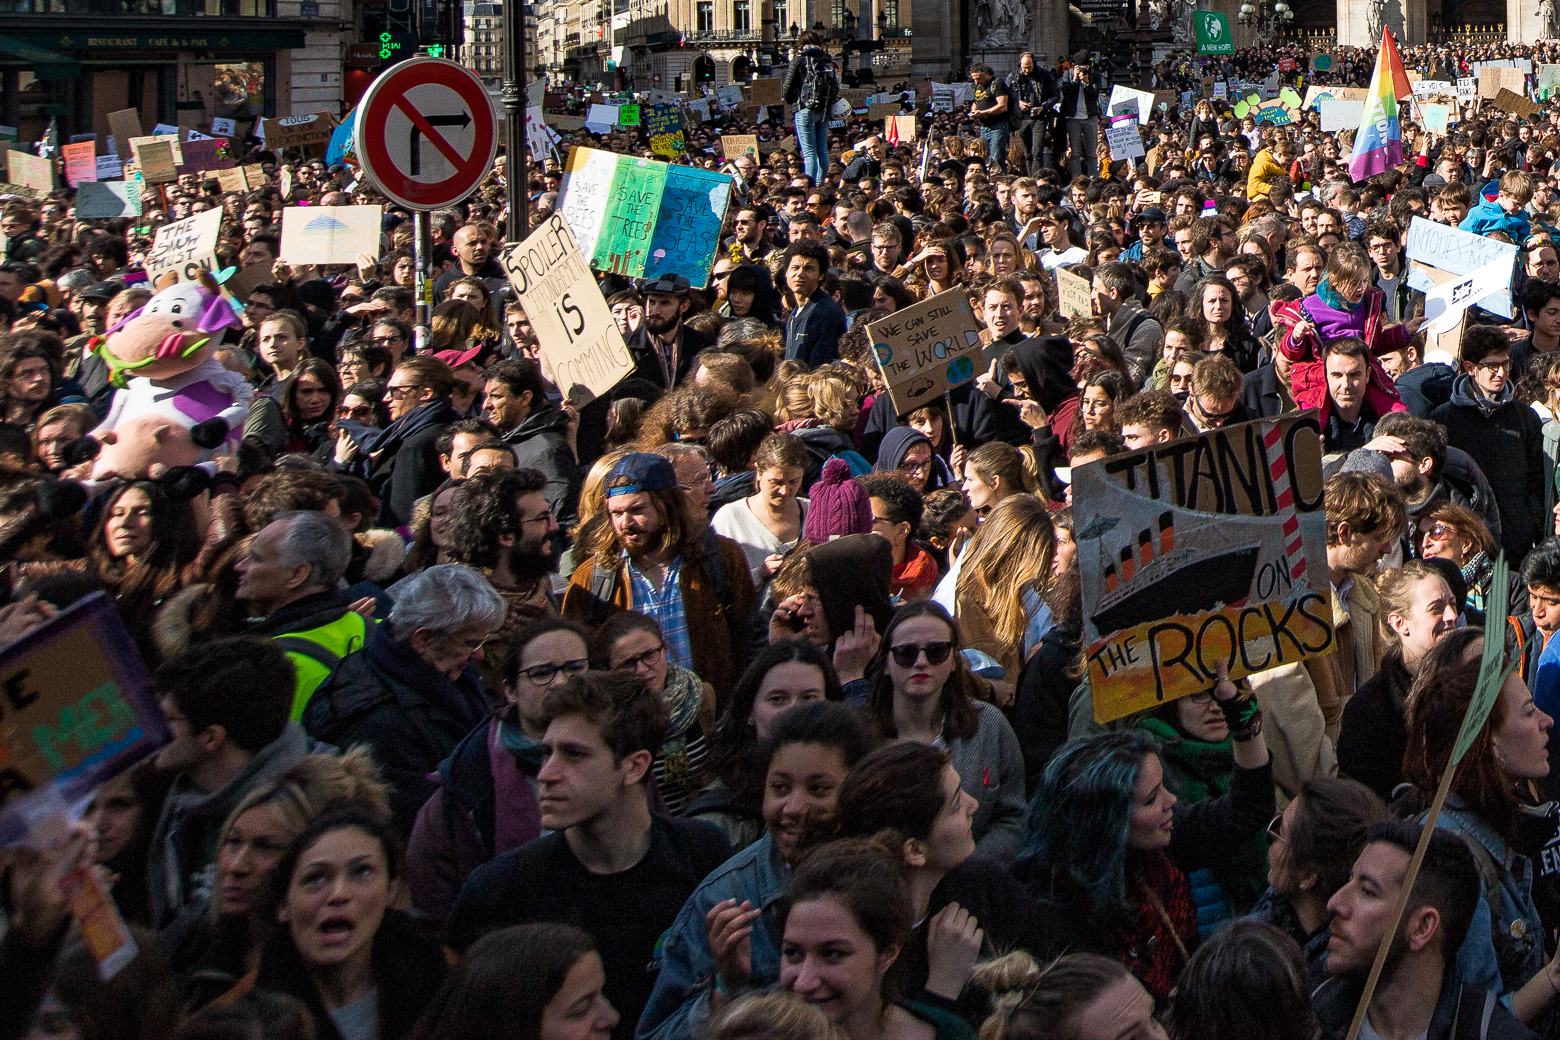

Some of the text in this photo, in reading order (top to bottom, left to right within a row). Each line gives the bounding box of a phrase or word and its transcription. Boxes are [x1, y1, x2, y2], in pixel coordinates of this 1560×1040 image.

[1218, 43, 1232, 51] HOPE
[284, 114, 311, 125] TOUS
[574, 180, 599, 196] SAVE
[617, 186, 654, 206] SAVE
[577, 194, 589, 207] THE
[627, 202, 642, 216] THE
[671, 197, 711, 217] SAVE
[162, 219, 196, 240] THE
[566, 206, 595, 230] BEES
[612, 215, 649, 241] TREES
[677, 213, 698, 229] THE
[661, 226, 712, 257] SEAS
[506, 214, 575, 295] SPOILER
[523, 250, 588, 321] L'EFFONDREMENT
[877, 305, 954, 340] WE CAN STILL
[906, 325, 940, 347] SAVE
[888, 329, 980, 376] THE WORLD
[1105, 417, 1326, 516] TITANIC
[1256, 554, 1294, 601] ON
[1088, 634, 1142, 679] THE
[1148, 591, 1334, 703] ROCKS
